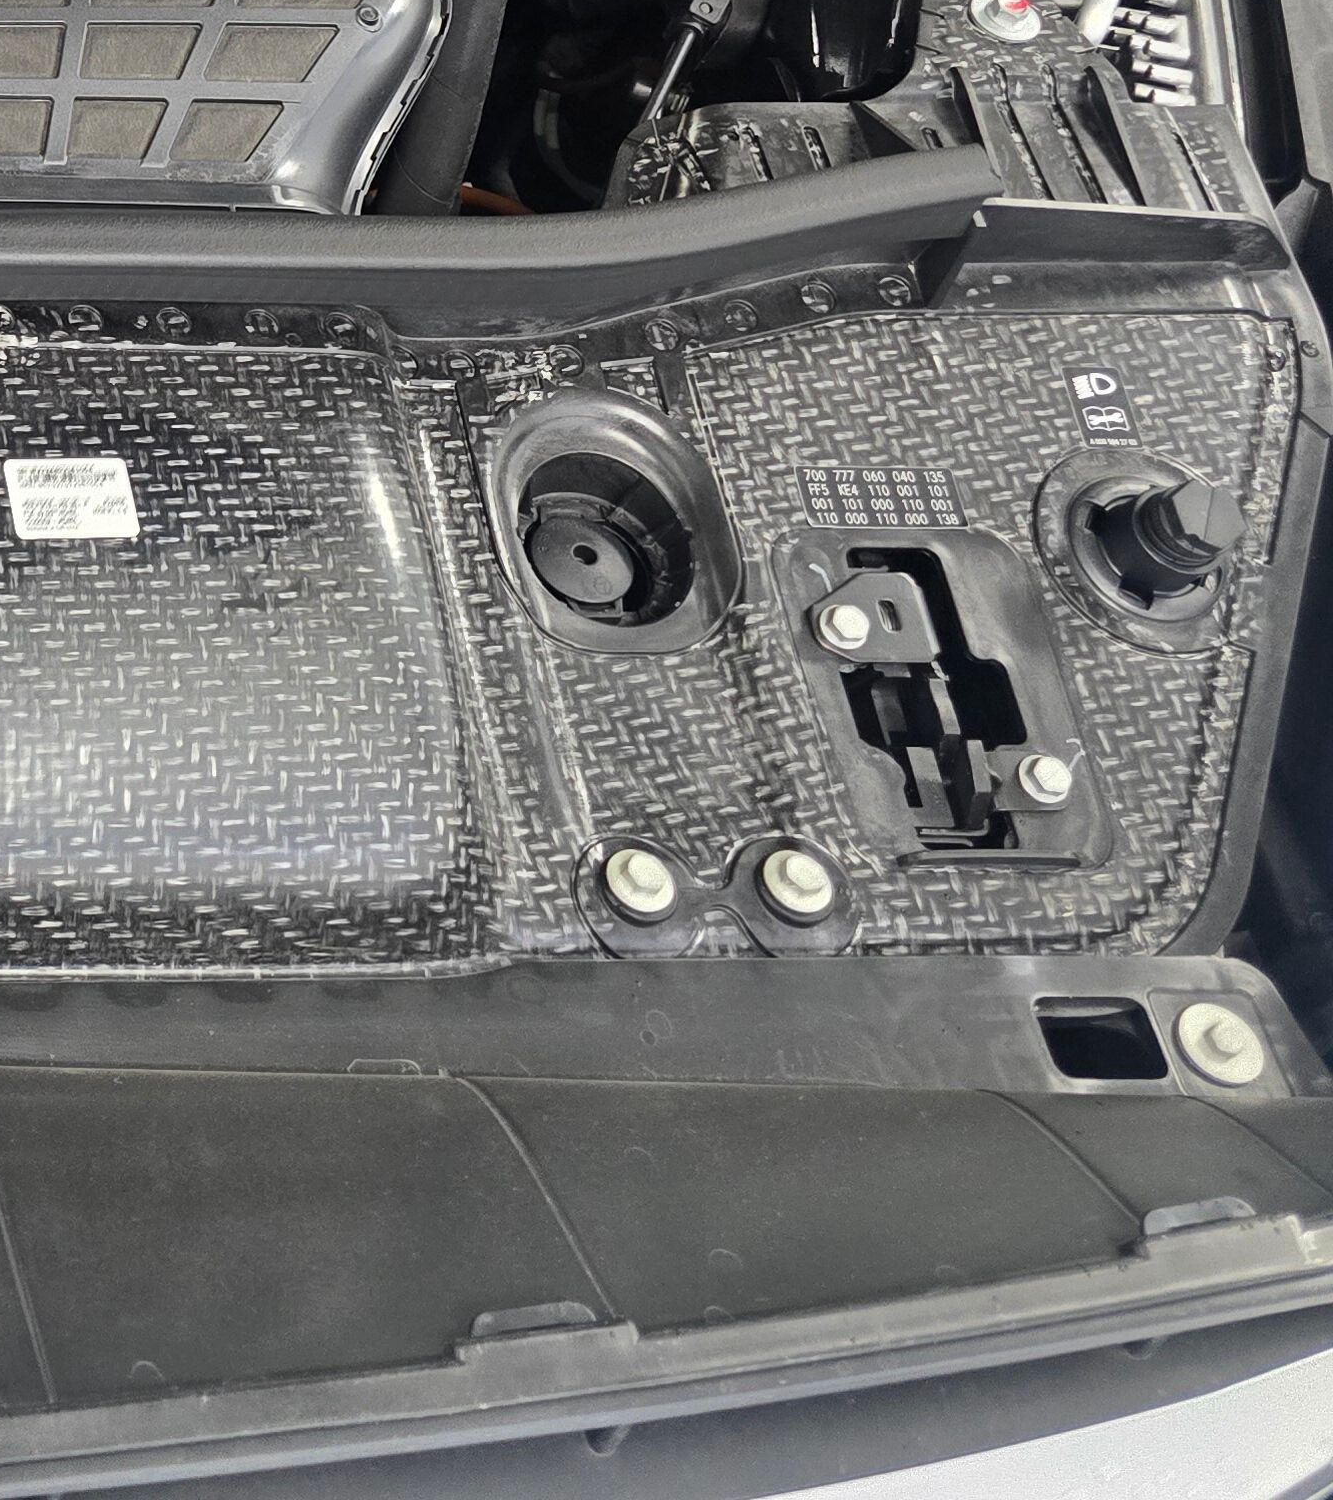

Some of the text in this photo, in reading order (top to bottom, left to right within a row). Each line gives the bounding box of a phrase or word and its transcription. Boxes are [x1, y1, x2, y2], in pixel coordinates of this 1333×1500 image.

[803, 469, 945, 483] 700 777 060 040 135
[808, 484, 949, 497] FF5 KE4 110 001 101
[812, 498, 953, 512] 001 101 000 110 001
[816, 512, 959, 525] 110 000 110 000 138
